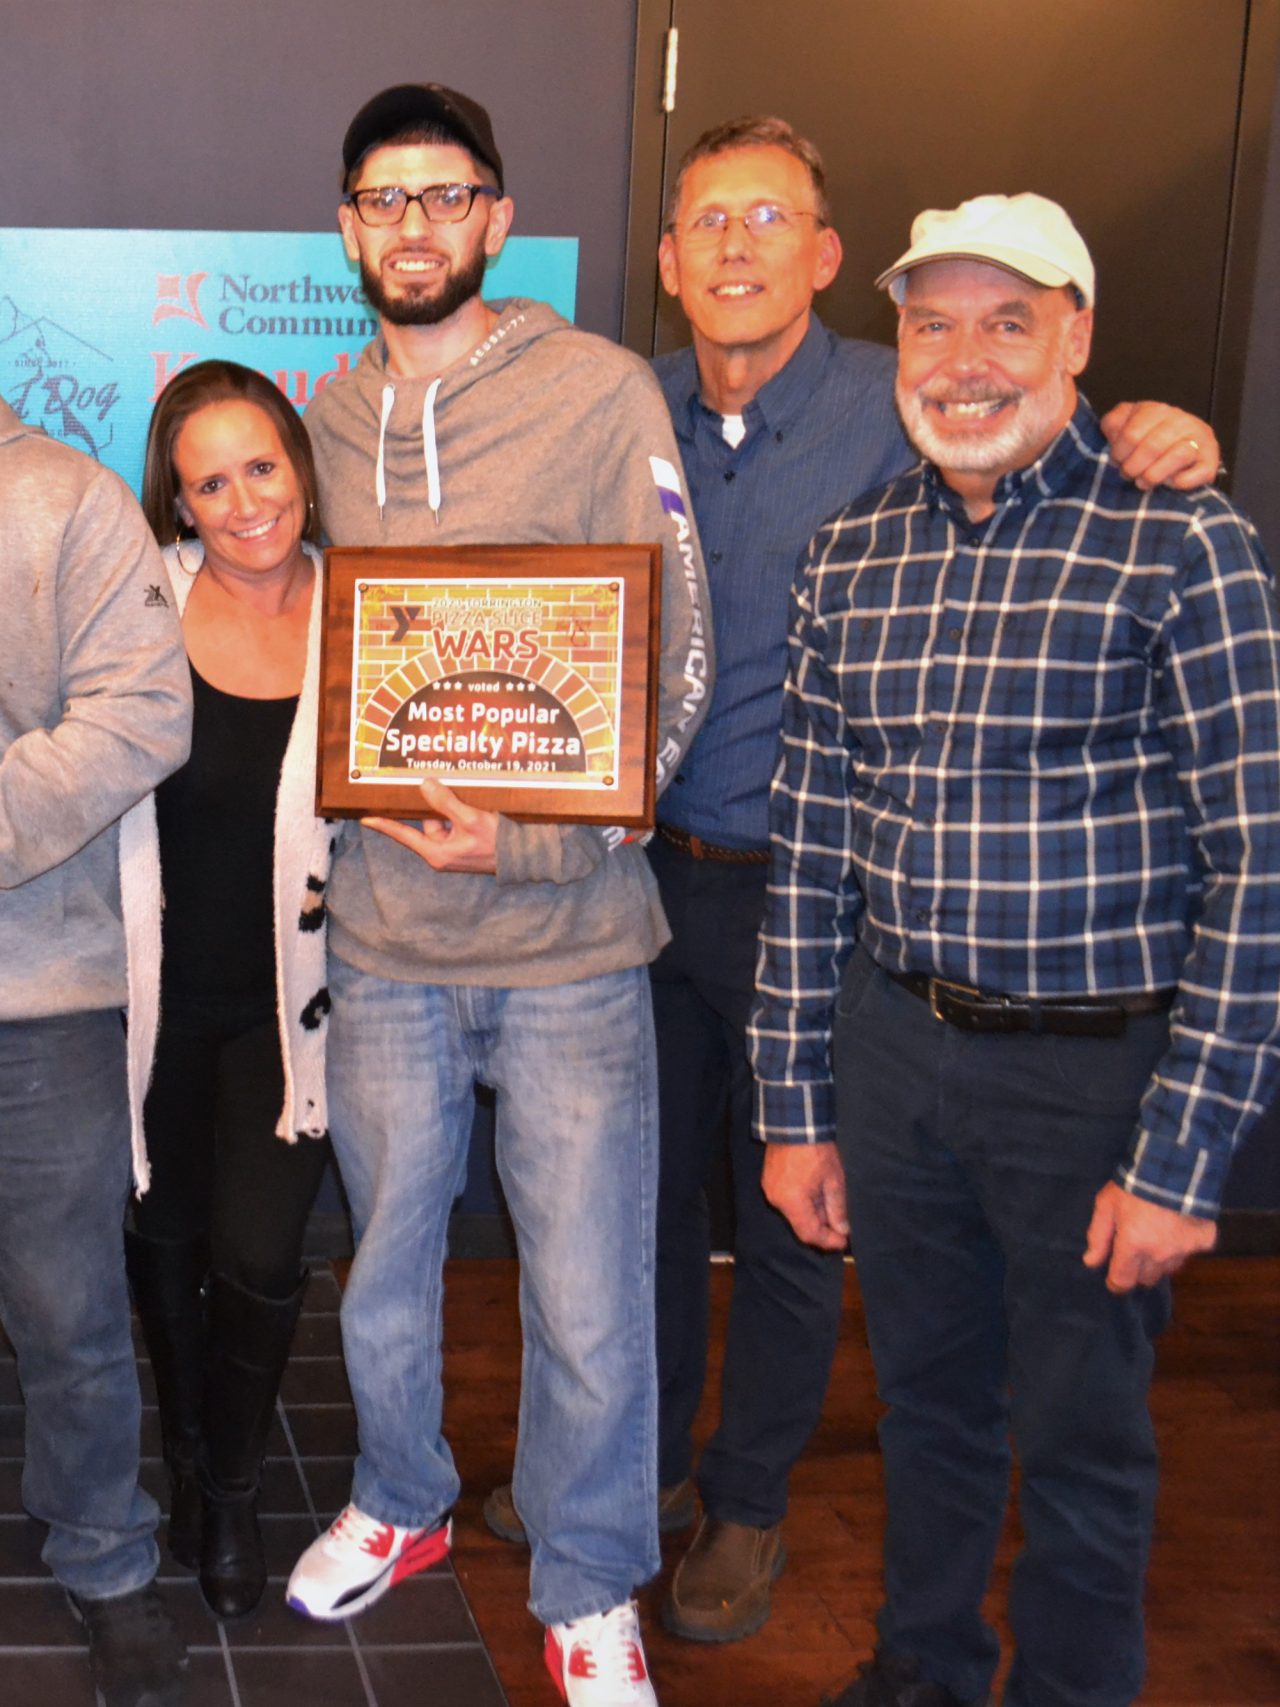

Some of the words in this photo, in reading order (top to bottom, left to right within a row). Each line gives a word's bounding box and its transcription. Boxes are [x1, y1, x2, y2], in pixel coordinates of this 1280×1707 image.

[432, 610, 486, 625] PIZZA
[432, 628, 540, 660] WARS
[468, 682, 500, 693] voted
[408, 701, 465, 722] Most
[471, 703, 560, 727] Popular
[386, 729, 504, 759] Specialty
[512, 731, 581, 755] Pizza
[406, 758, 455, 771] Tuesday,
[458, 759, 503, 770] October
[527, 760, 557, 771] 2021
